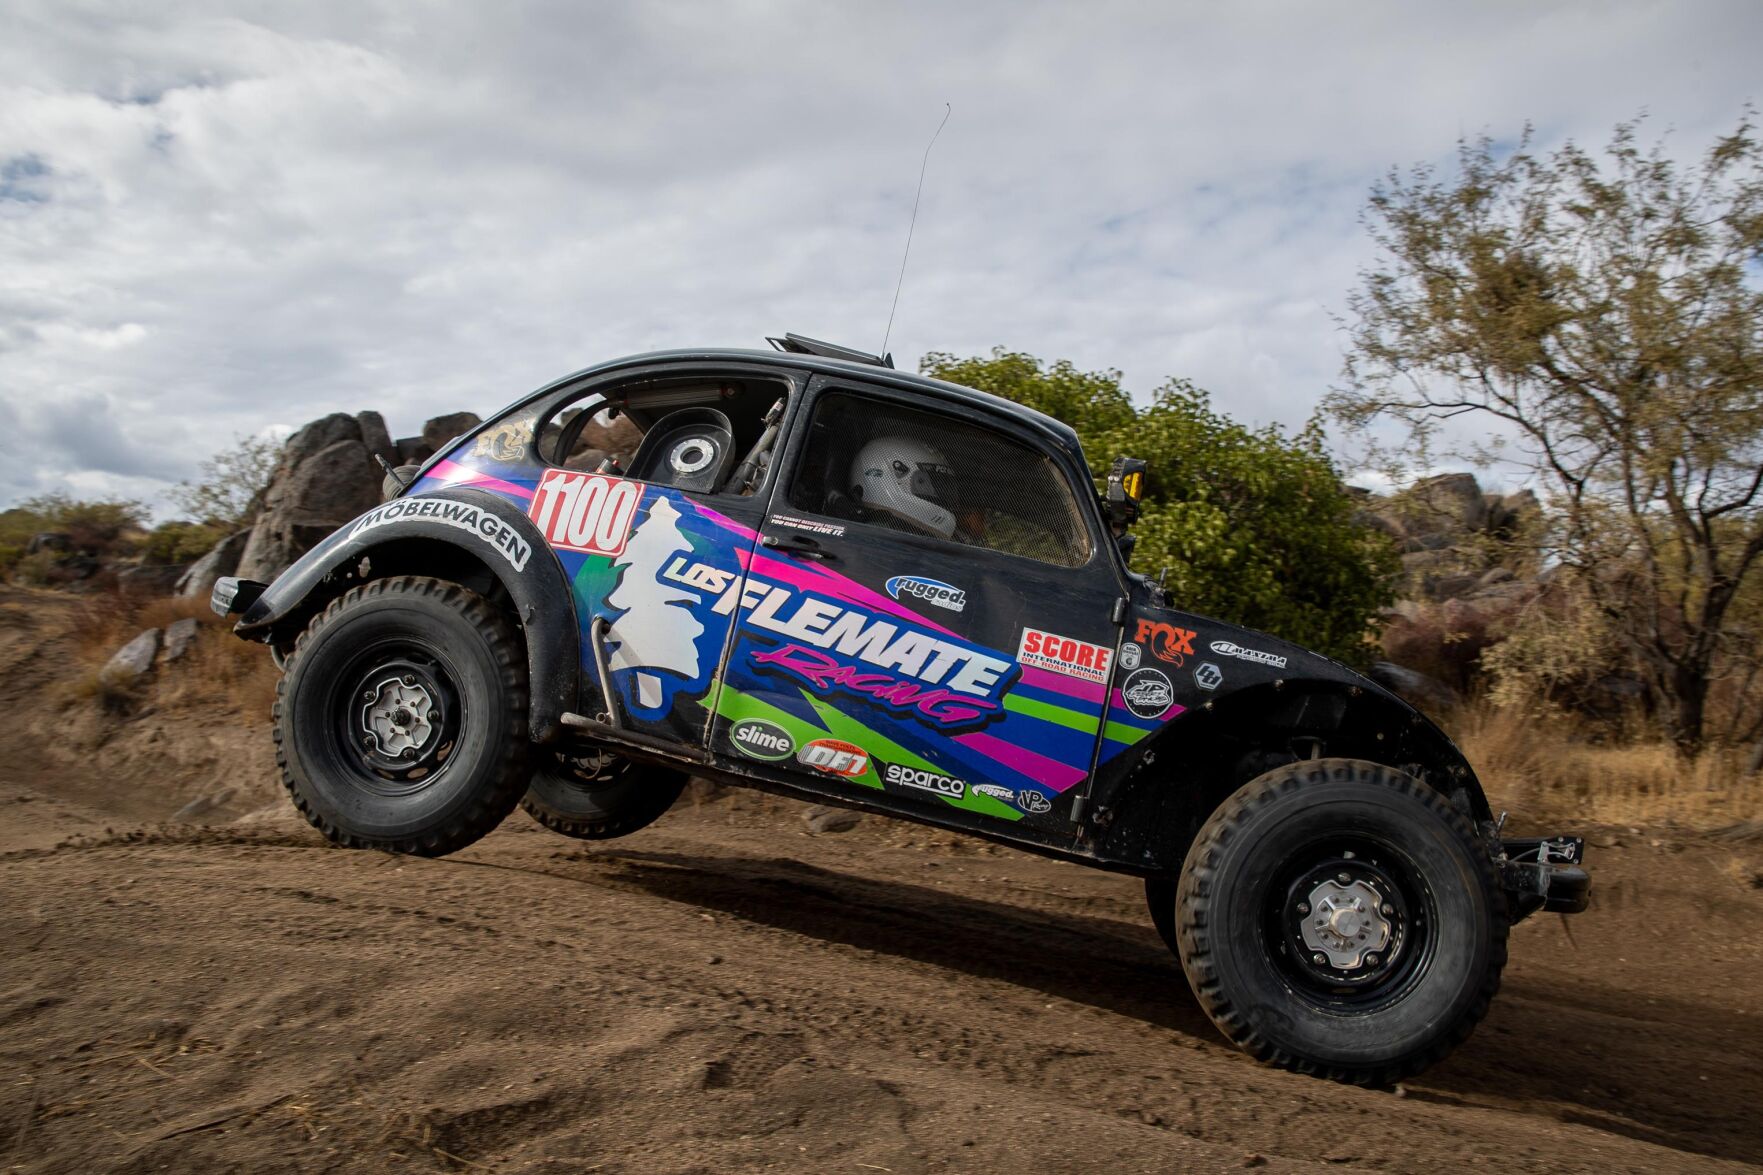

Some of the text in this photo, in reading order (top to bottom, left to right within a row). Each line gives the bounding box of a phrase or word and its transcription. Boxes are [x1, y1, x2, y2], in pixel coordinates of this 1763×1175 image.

[537, 473, 637, 551] 1100
[353, 500, 527, 565] MÖBELWAGEN
[812, 526, 833, 535] LIVE
[663, 556, 1012, 697] LOS FLEMATE
[1134, 618, 1197, 667] FOX
[1023, 652, 1104, 676] INTERNATIONAL
[1024, 631, 1110, 671] SCORE
[1069, 668, 1105, 682] RACING
[735, 725, 790, 752] slime
[887, 764, 965, 794] sparco
